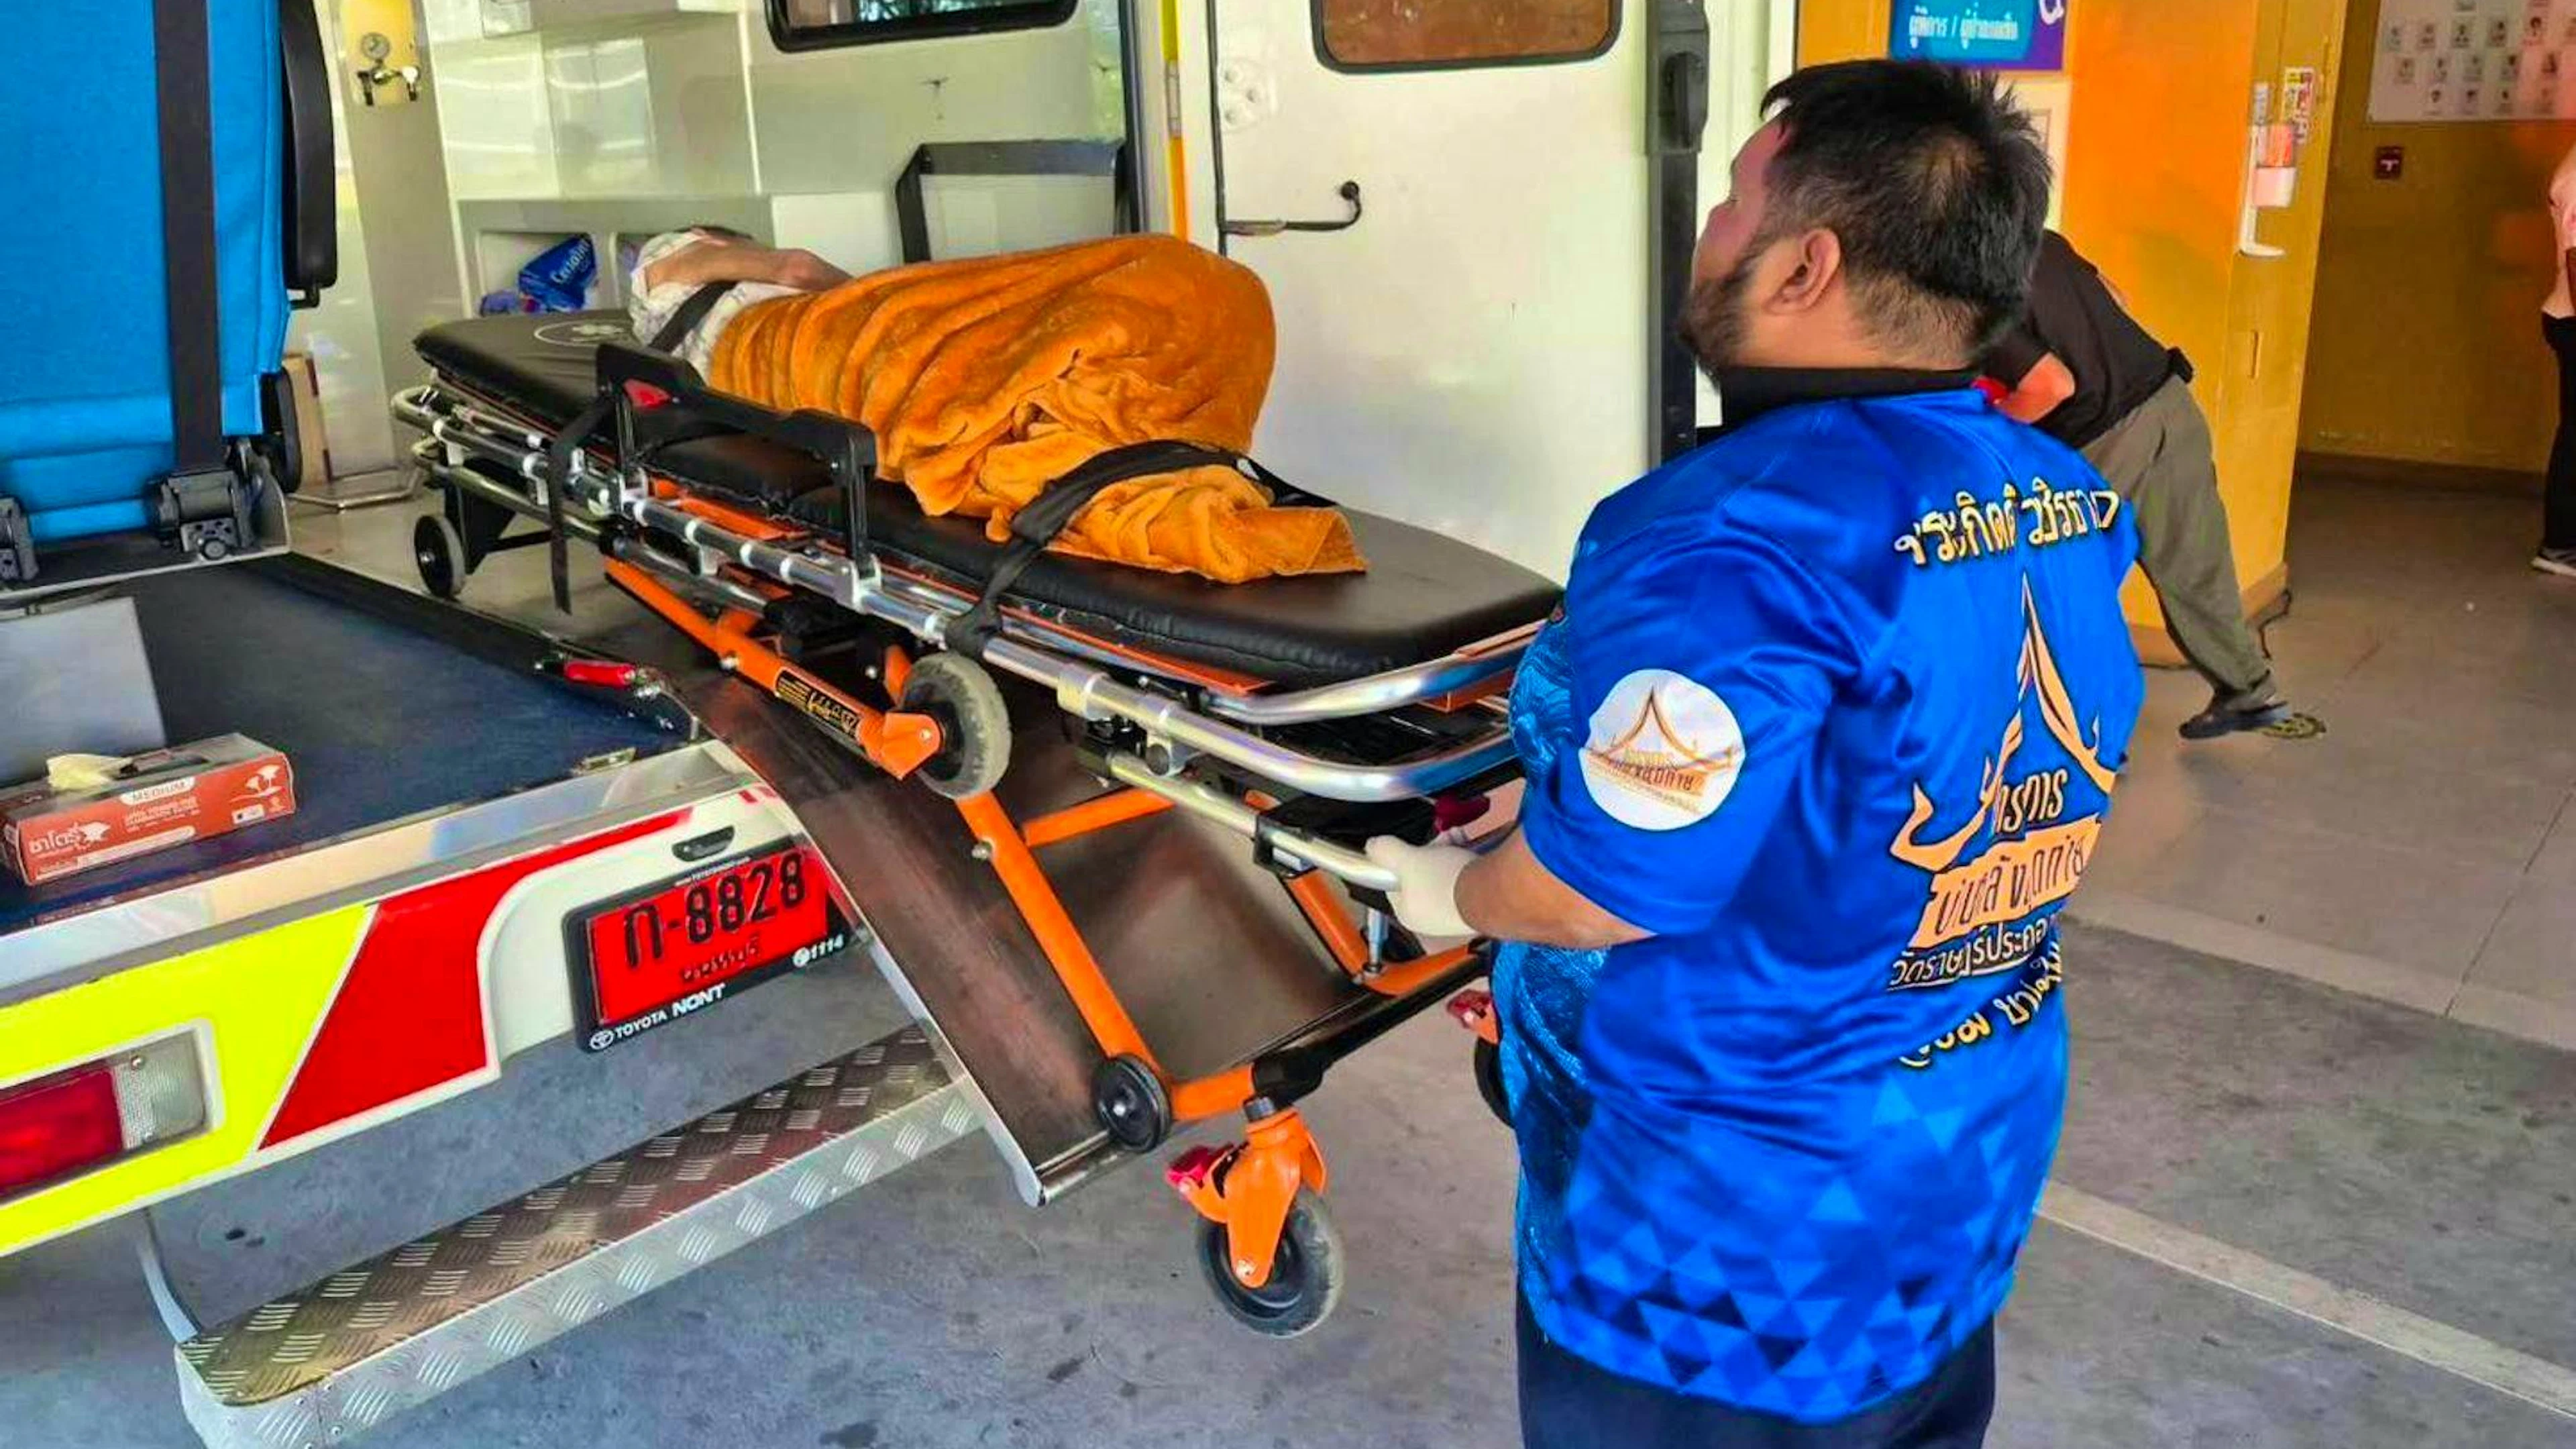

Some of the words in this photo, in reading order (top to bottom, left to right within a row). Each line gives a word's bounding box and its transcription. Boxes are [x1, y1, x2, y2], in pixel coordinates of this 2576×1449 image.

[1951, 14, 1958, 38] /
[625, 852, 806, 968] ก-8828
[614, 1009, 667, 1039] TOYOTA
[672, 982, 727, 1017] NONT
[808, 932, 845, 961] 1114
